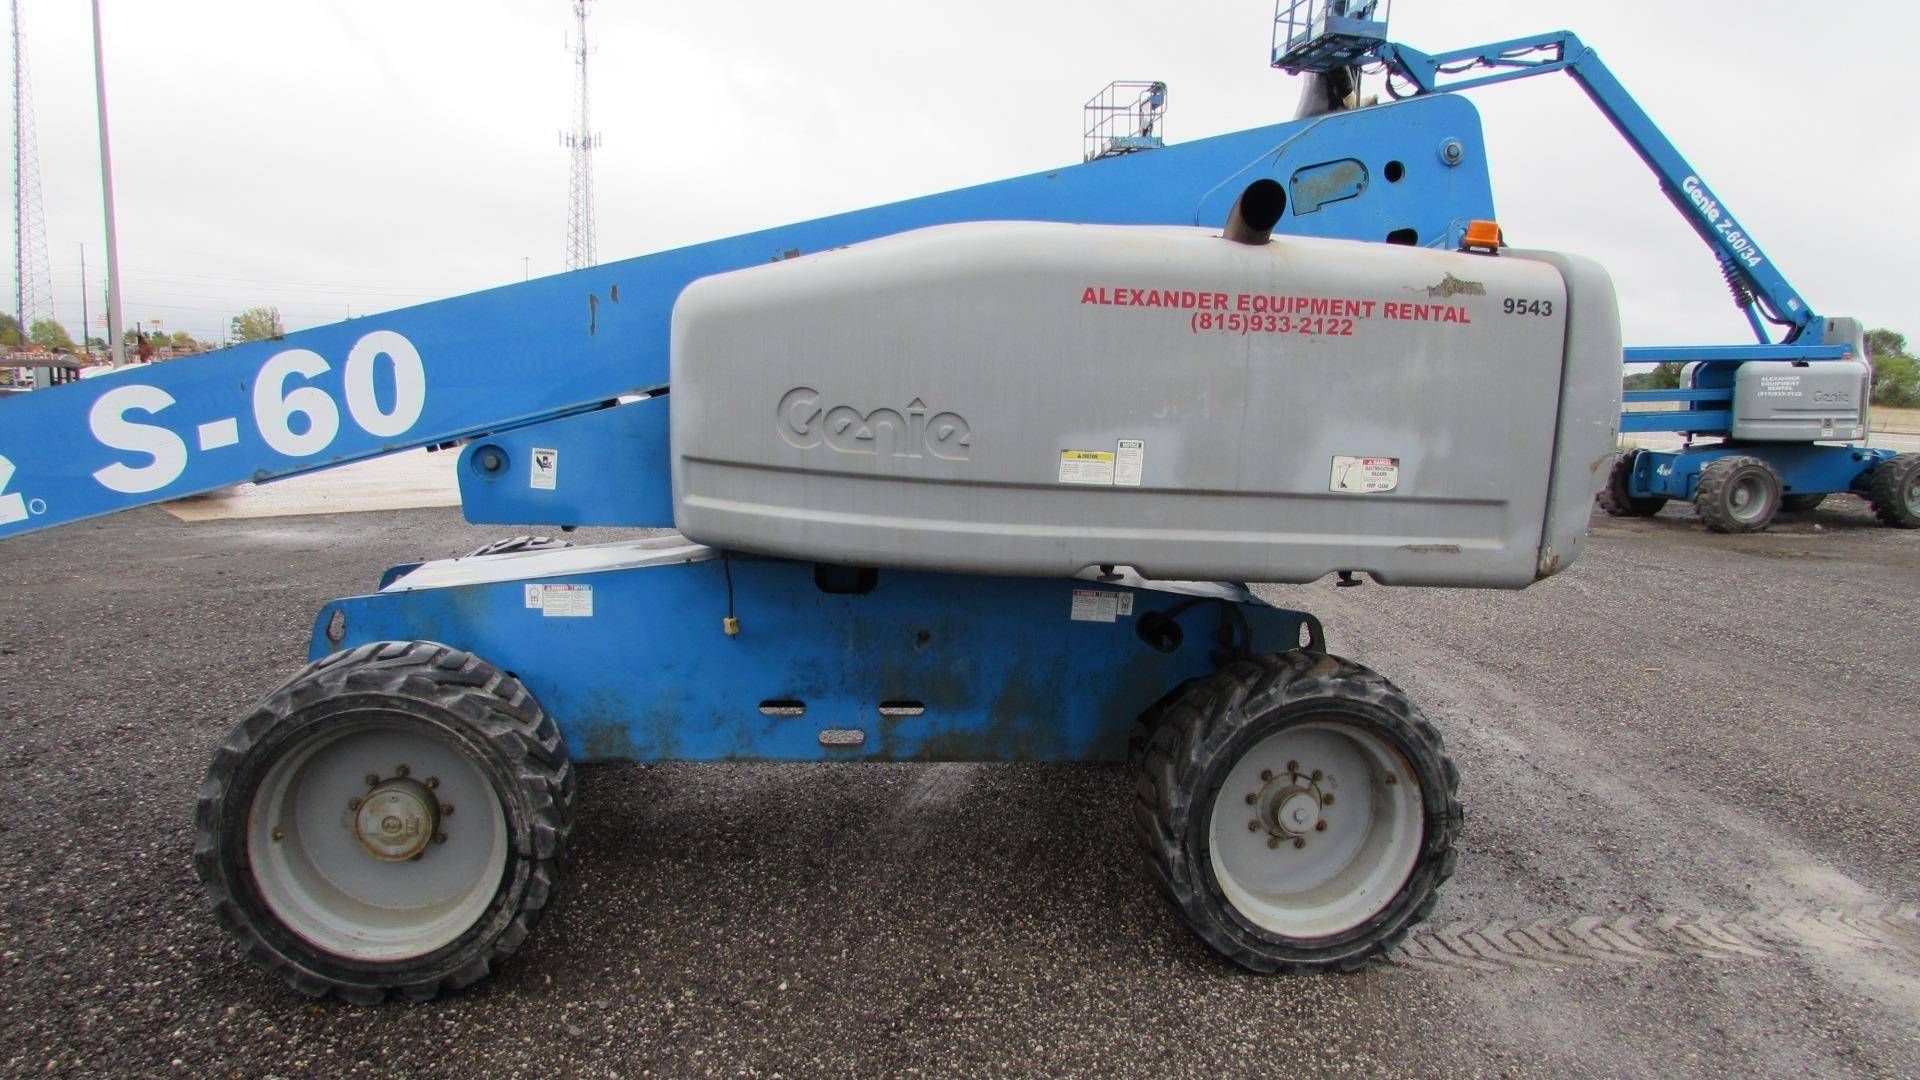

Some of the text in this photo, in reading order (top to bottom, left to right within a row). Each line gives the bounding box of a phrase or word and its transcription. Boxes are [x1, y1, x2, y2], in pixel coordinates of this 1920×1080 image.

[1682, 176, 1720, 223] Genie
[1081, 287, 1471, 324] ALEXANDER EQUIPMENT RENTAL
[1190, 312, 1353, 336] (815)933-2122
[1503, 297, 1553, 317] 9543
[90, 331, 426, 493] S-60
[777, 386, 970, 461] Genie
